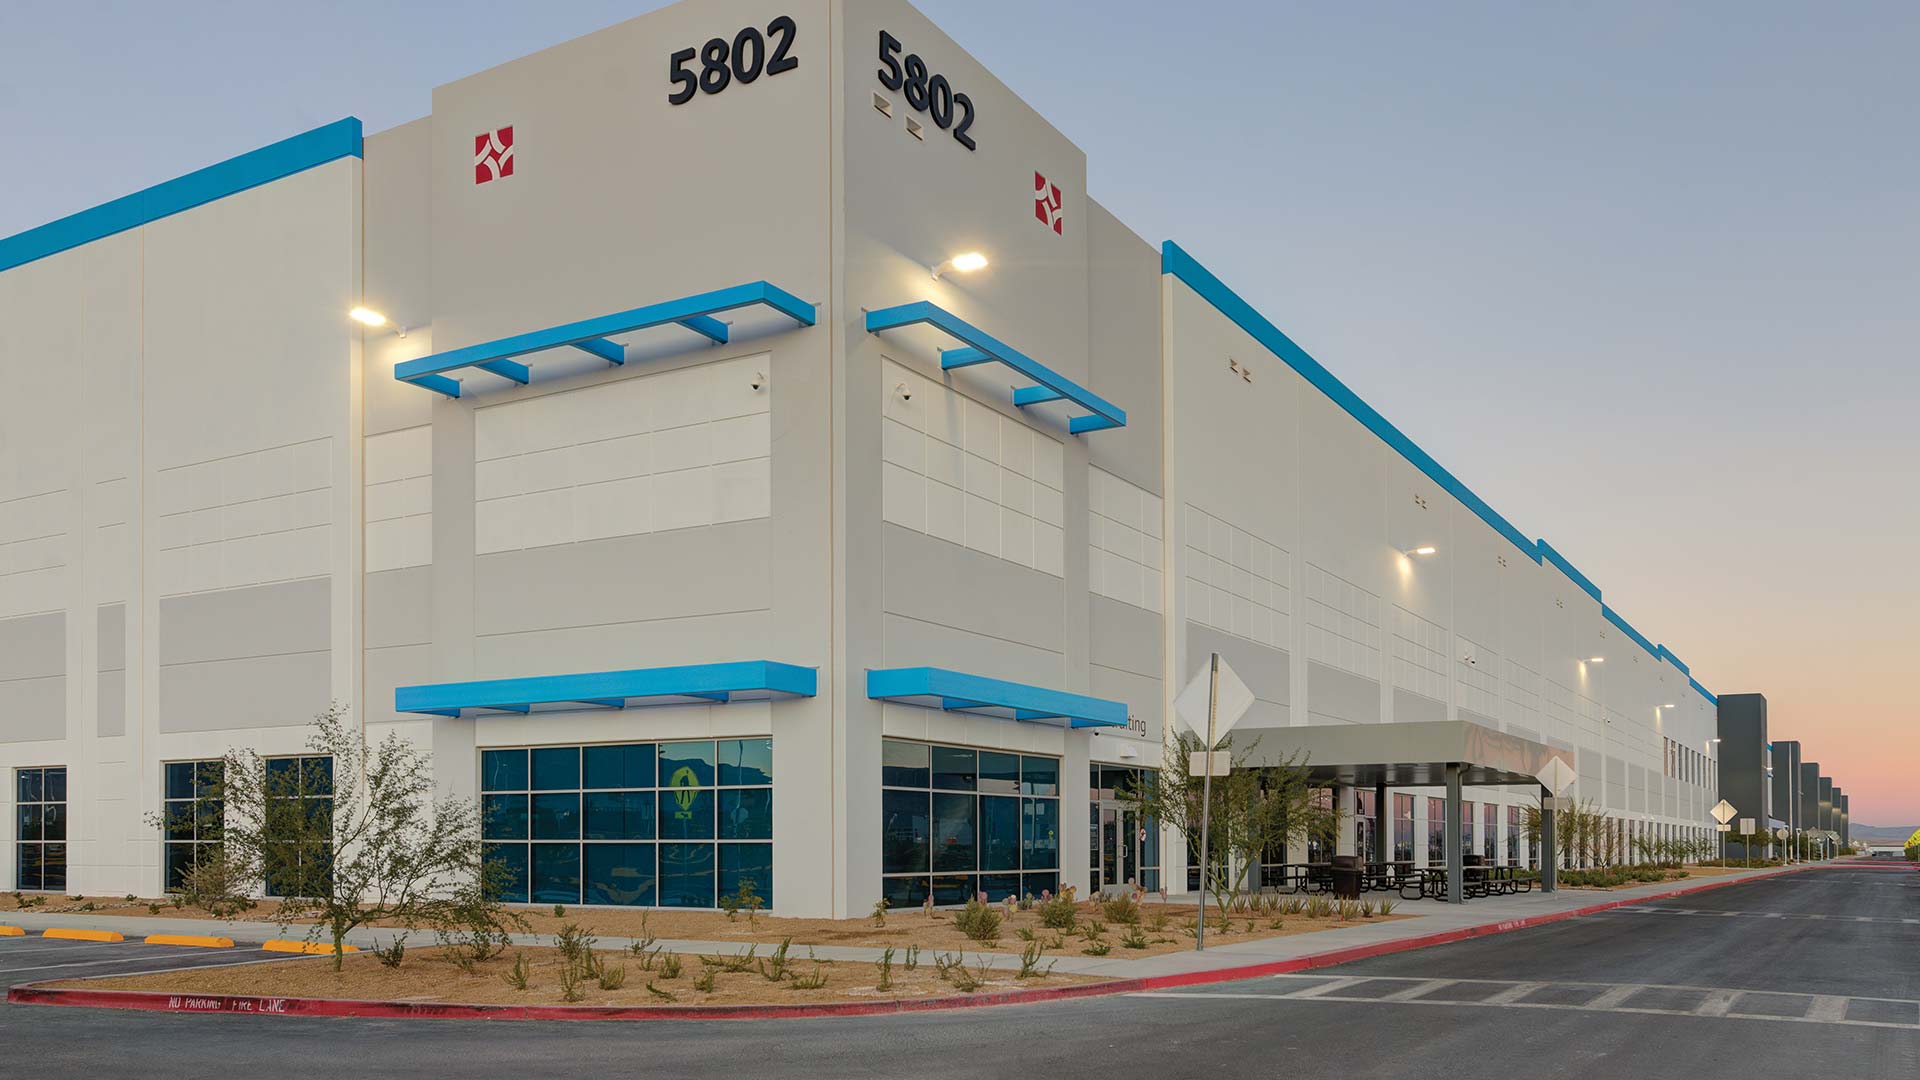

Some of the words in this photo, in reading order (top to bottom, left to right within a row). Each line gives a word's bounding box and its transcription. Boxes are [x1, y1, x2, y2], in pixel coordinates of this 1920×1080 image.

[668, 16, 798, 105] 5802
[877, 30, 976, 151] 5802
[168, 996, 181, 1009] NO
[184, 998, 220, 1010] PARKING
[231, 1000, 253, 1011] FIRE
[259, 999, 286, 1013] LANE
